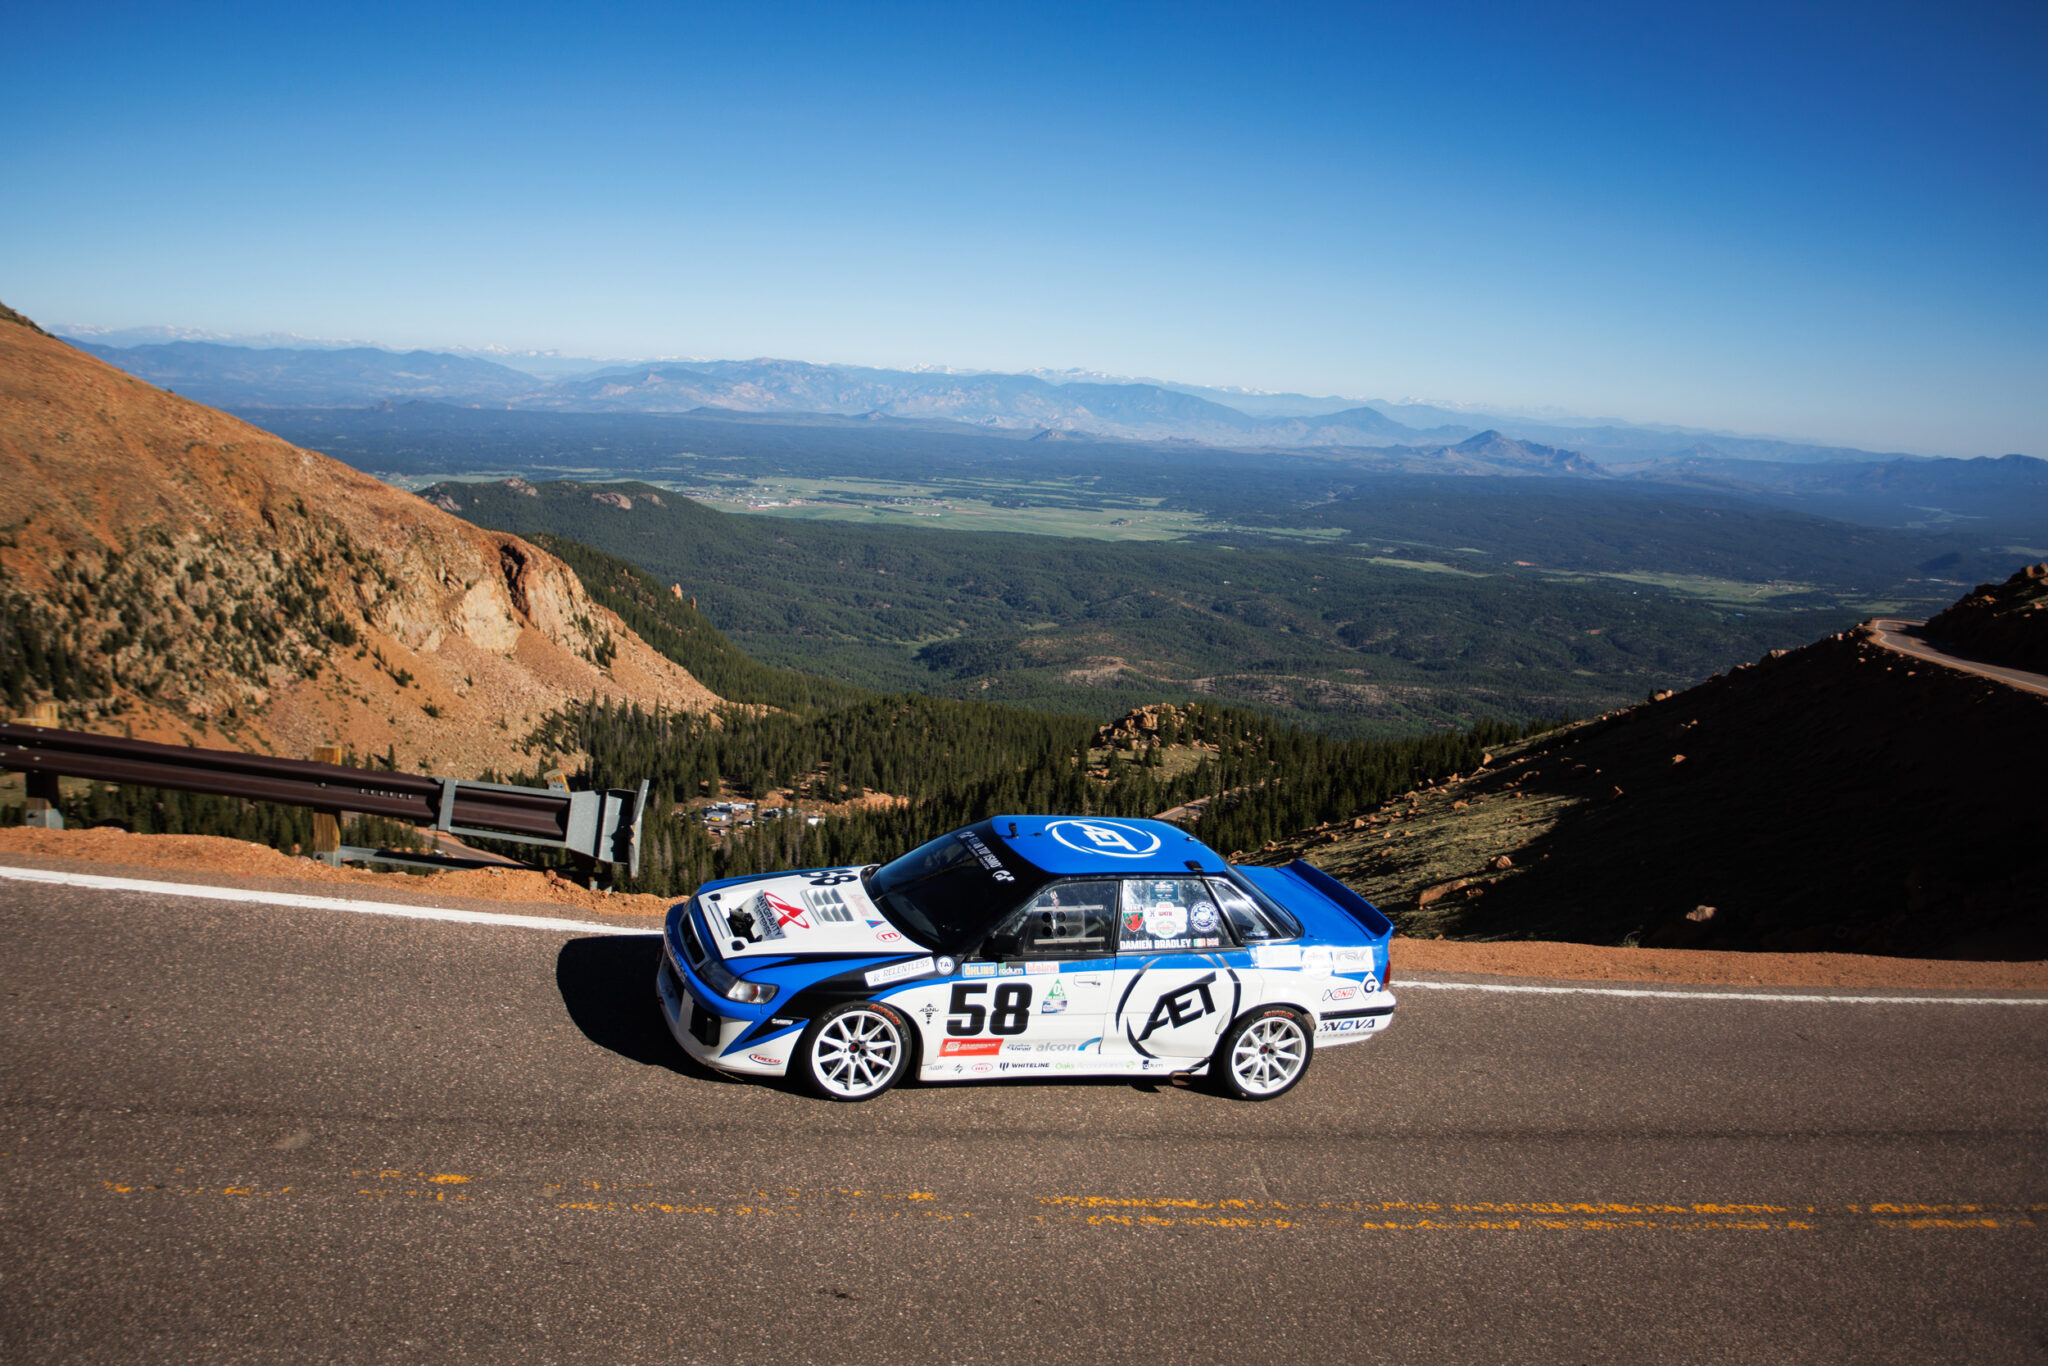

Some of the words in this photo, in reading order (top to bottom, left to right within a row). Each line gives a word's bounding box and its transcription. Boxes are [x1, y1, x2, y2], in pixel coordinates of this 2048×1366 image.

[756, 894, 783, 936] ANTIGRAVITY
[1120, 939, 1153, 950] DAMIEN
[1154, 938, 1192, 948] BRADLEY
[883, 957, 931, 978] RELENTLESS
[1363, 979, 1376, 993] G
[945, 982, 1033, 1037] 58
[1328, 1018, 1376, 1031] NOVA
[1036, 1042, 1076, 1052] alcon
